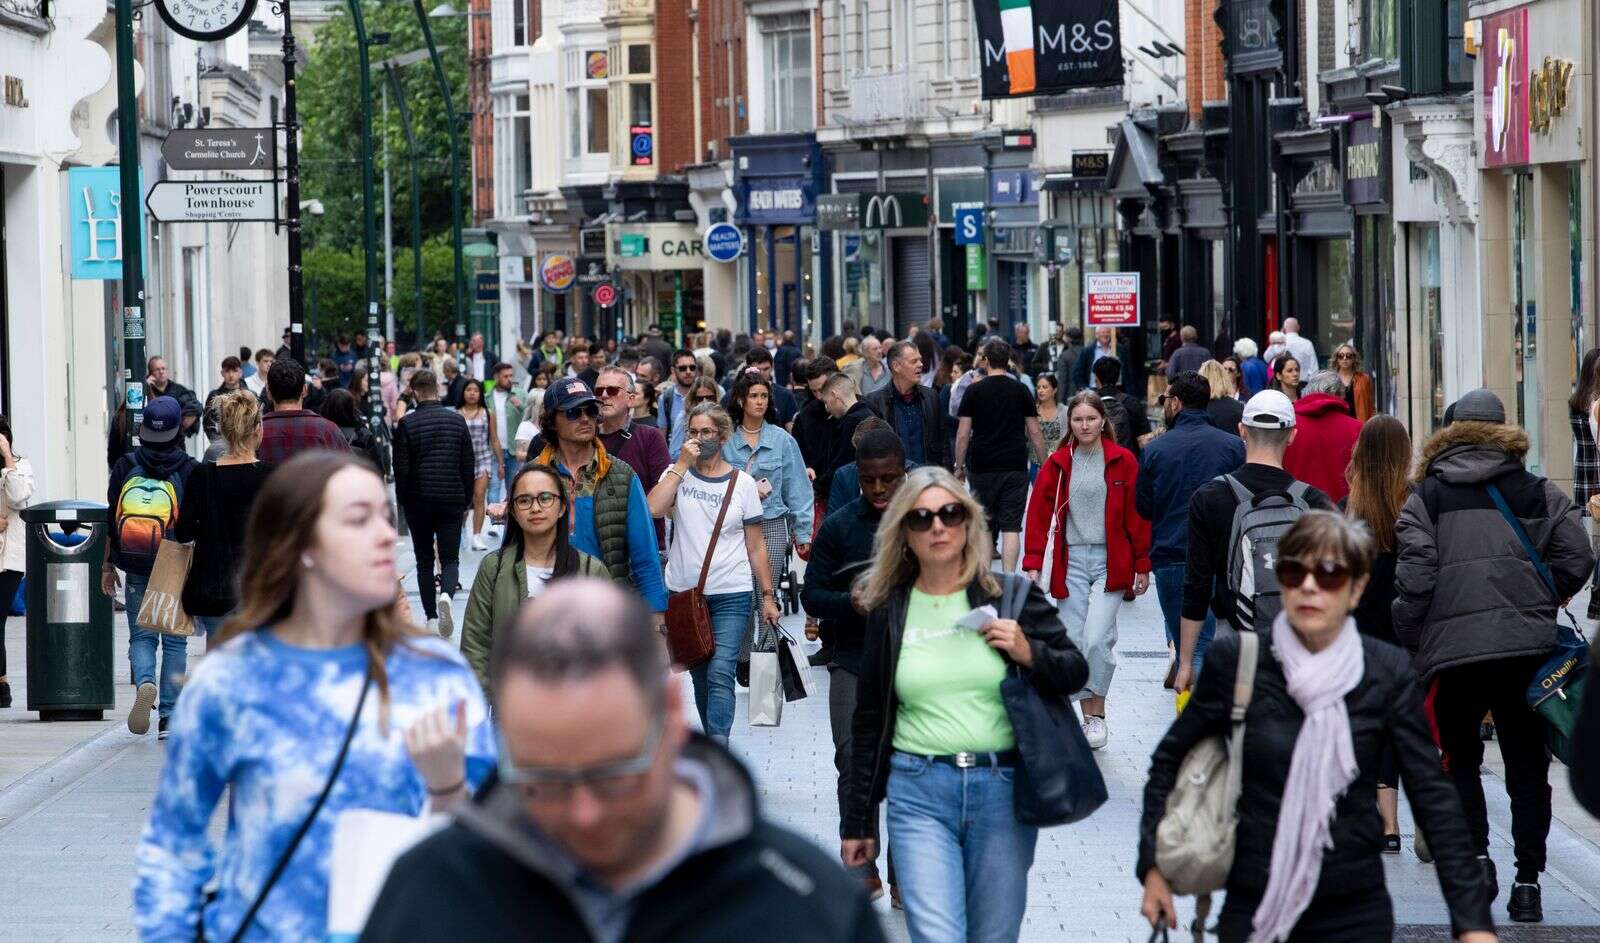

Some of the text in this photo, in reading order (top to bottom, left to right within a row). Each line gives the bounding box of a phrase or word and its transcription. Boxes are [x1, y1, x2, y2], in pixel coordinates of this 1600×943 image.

[172, 3, 181, 16] 8
[232, 1, 240, 13] 4
[187, 14, 196, 27] 7
[203, 18, 212, 30] 6
[220, 13, 228, 26] 5
[1038, 19, 1114, 56] M&S
[206, 138, 238, 147] Teresa's
[184, 150, 247, 160] Carmelite Church
[1075, 155, 1105, 169] M&S
[184, 184, 264, 196] Powerscourt
[184, 196, 256, 209] Townhouse
[963, 215, 977, 238] S
[710, 231, 737, 241] HEALTH
[709, 241, 741, 250] MATTERS
